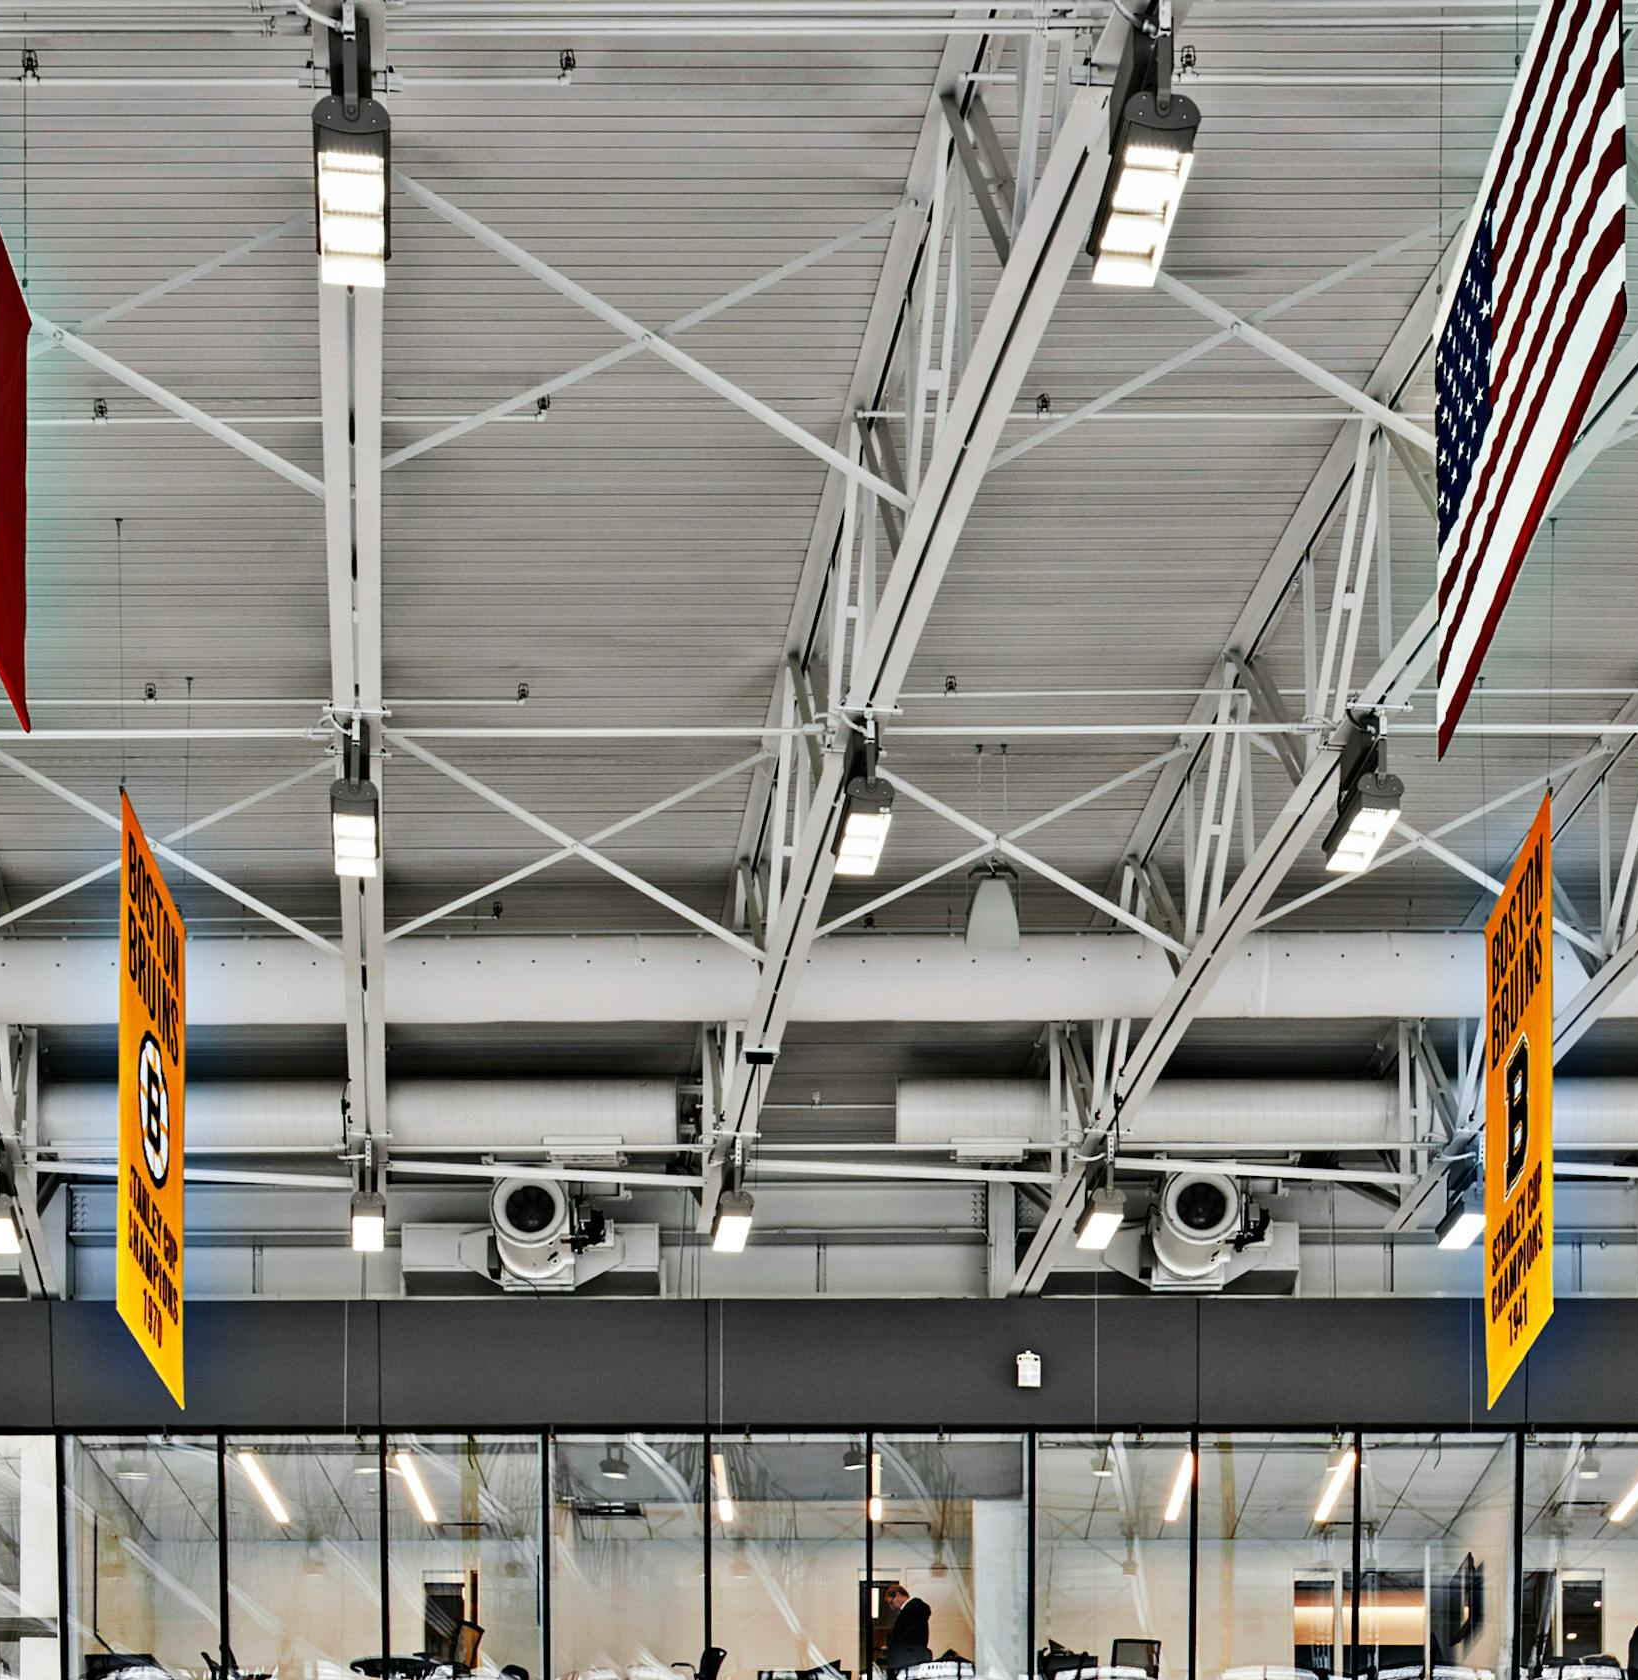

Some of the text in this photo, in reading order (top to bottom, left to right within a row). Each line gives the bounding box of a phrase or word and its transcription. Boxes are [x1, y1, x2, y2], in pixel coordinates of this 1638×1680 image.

[128, 837, 180, 983] BOSTON
[1491, 835, 1544, 996] BOSTON
[128, 919, 179, 1067] BRUINS
[1492, 917, 1543, 1070] BRUINS
[128, 1215, 179, 1326] CHAMPIONS
[143, 1288, 163, 1349] 1970
[1491, 1211, 1544, 1325] CHAMPIONS
[1508, 1287, 1529, 1347] 1941
